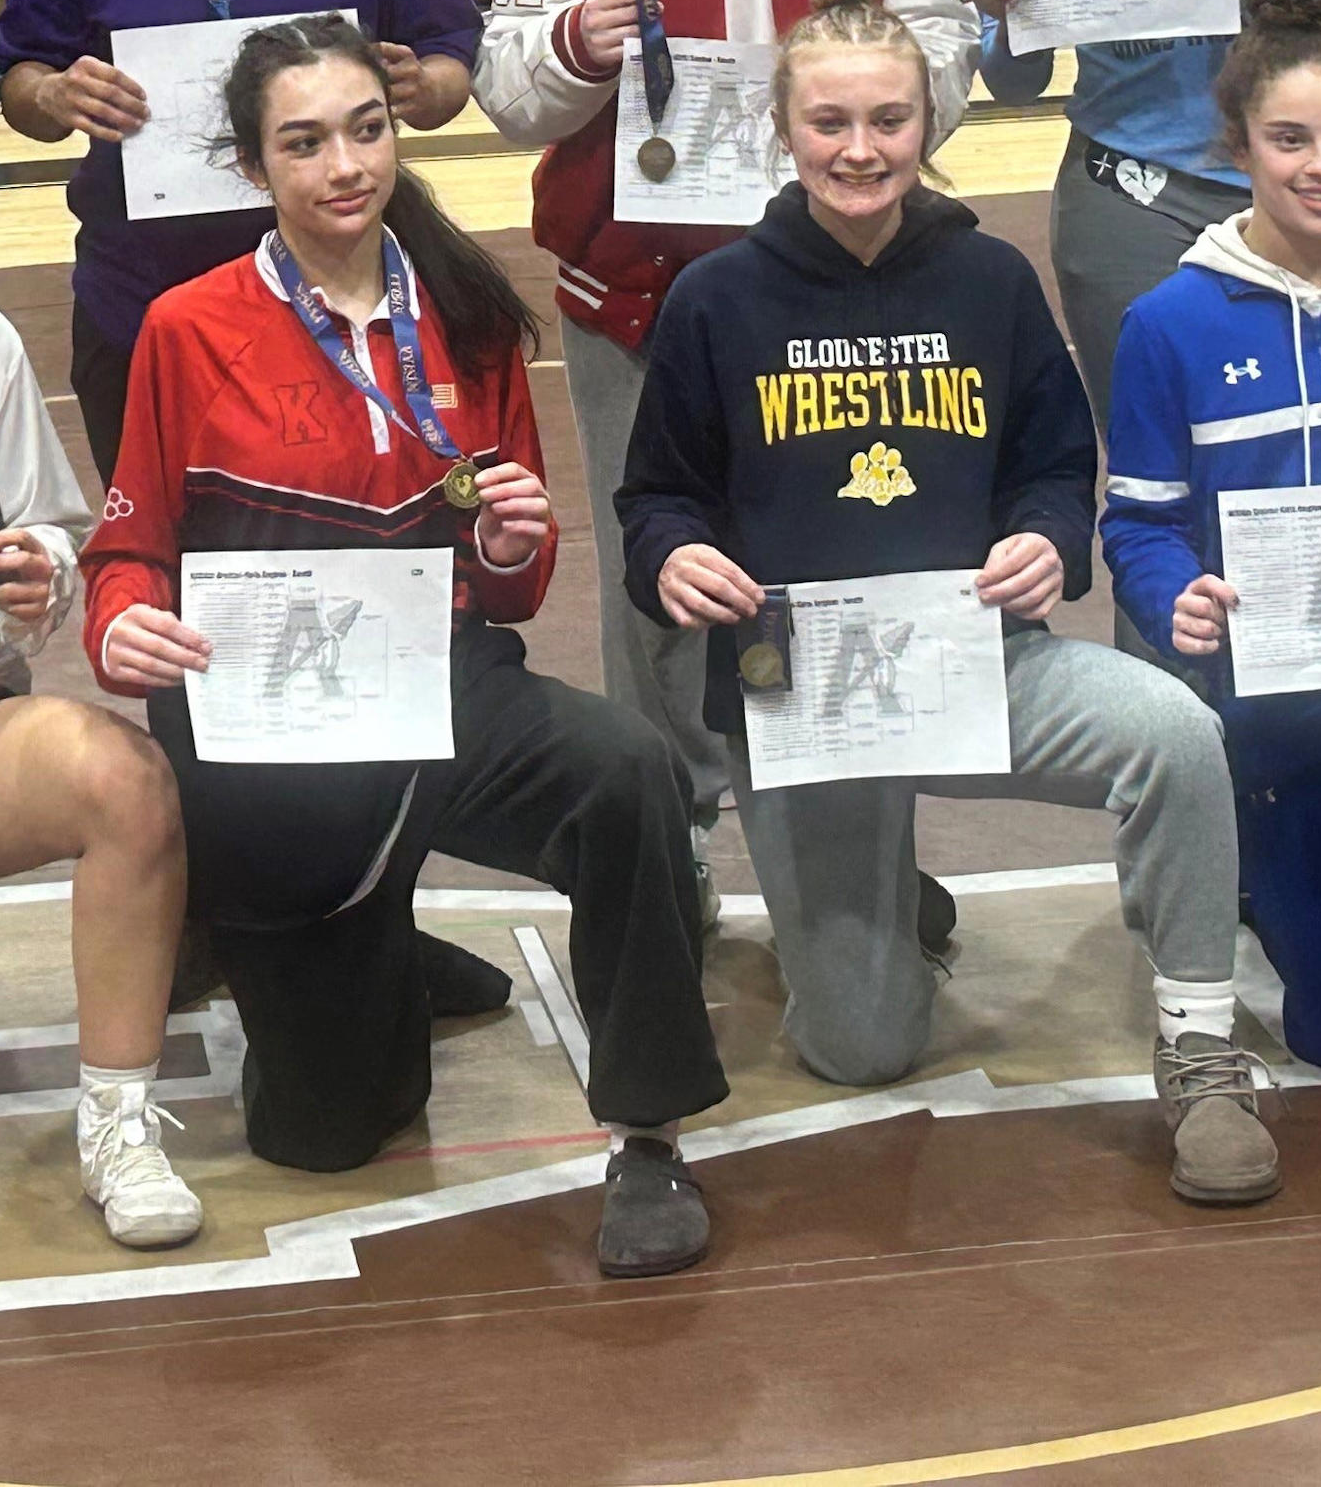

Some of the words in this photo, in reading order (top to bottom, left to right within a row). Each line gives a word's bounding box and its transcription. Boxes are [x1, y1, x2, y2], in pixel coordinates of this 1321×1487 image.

[786, 333, 951, 369] GLOUCESTER
[274, 380, 329, 446] K
[755, 367, 988, 446] WRESTLING
